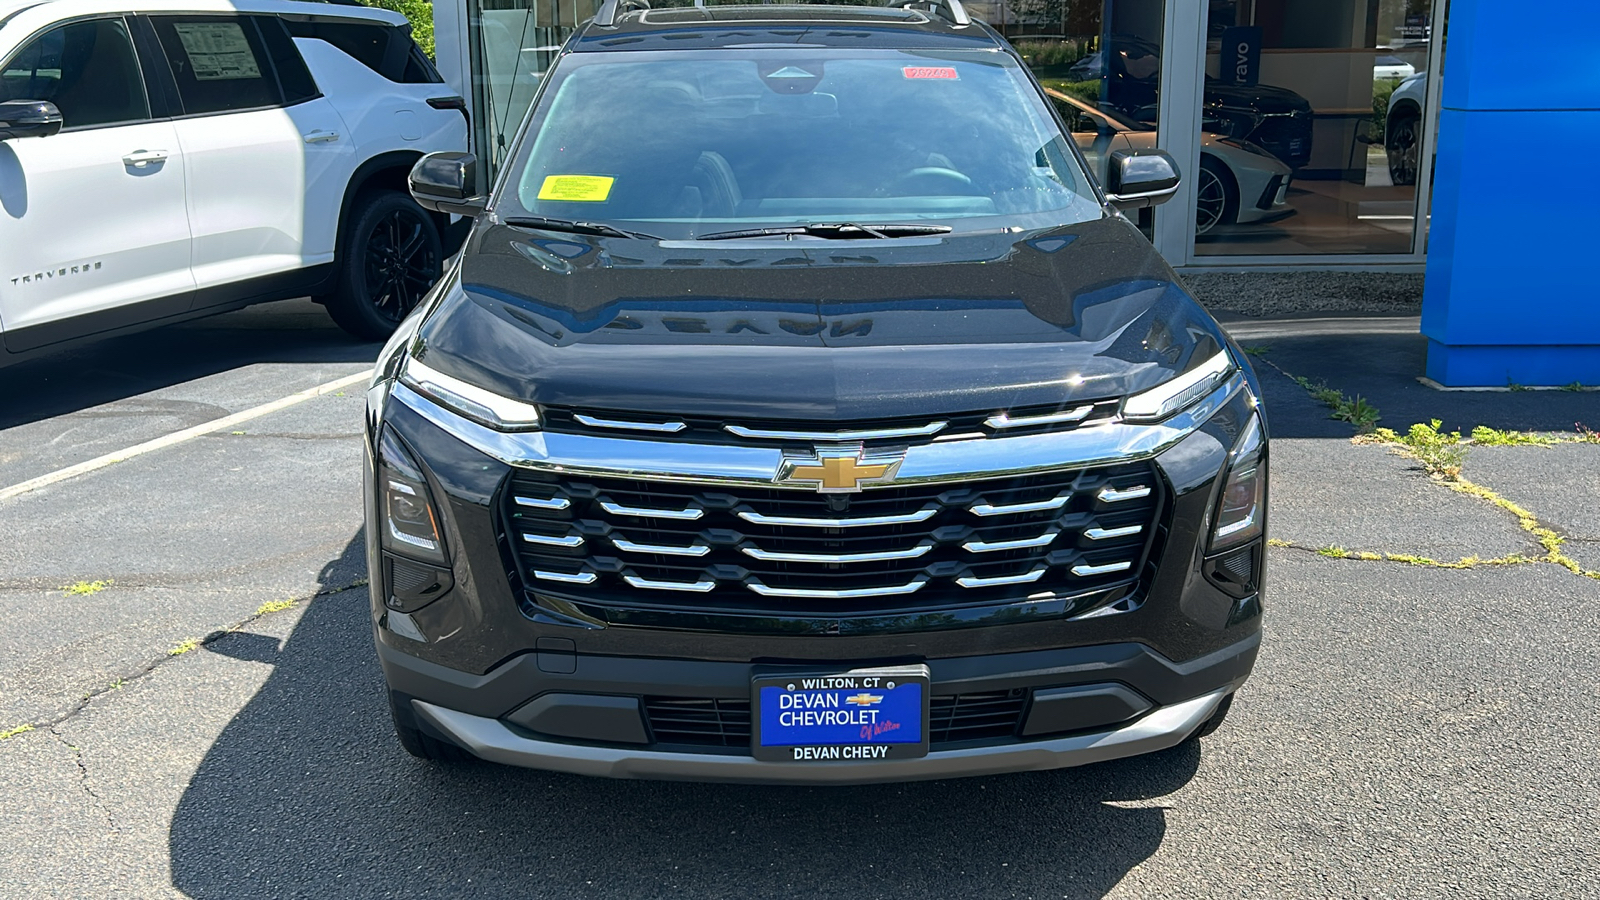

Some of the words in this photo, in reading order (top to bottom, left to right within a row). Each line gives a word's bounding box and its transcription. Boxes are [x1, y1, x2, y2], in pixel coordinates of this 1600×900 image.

[1236, 42, 1249, 82] ravo
[11, 261, 102, 286] TRAVERSE
[802, 678, 858, 689] WILTON,
[863, 678, 880, 688] CT
[780, 693, 838, 709] DEVAN
[779, 710, 879, 726] CHEVROLET
[794, 747, 839, 760] DEVAN
[843, 745, 888, 758] CHEVY
